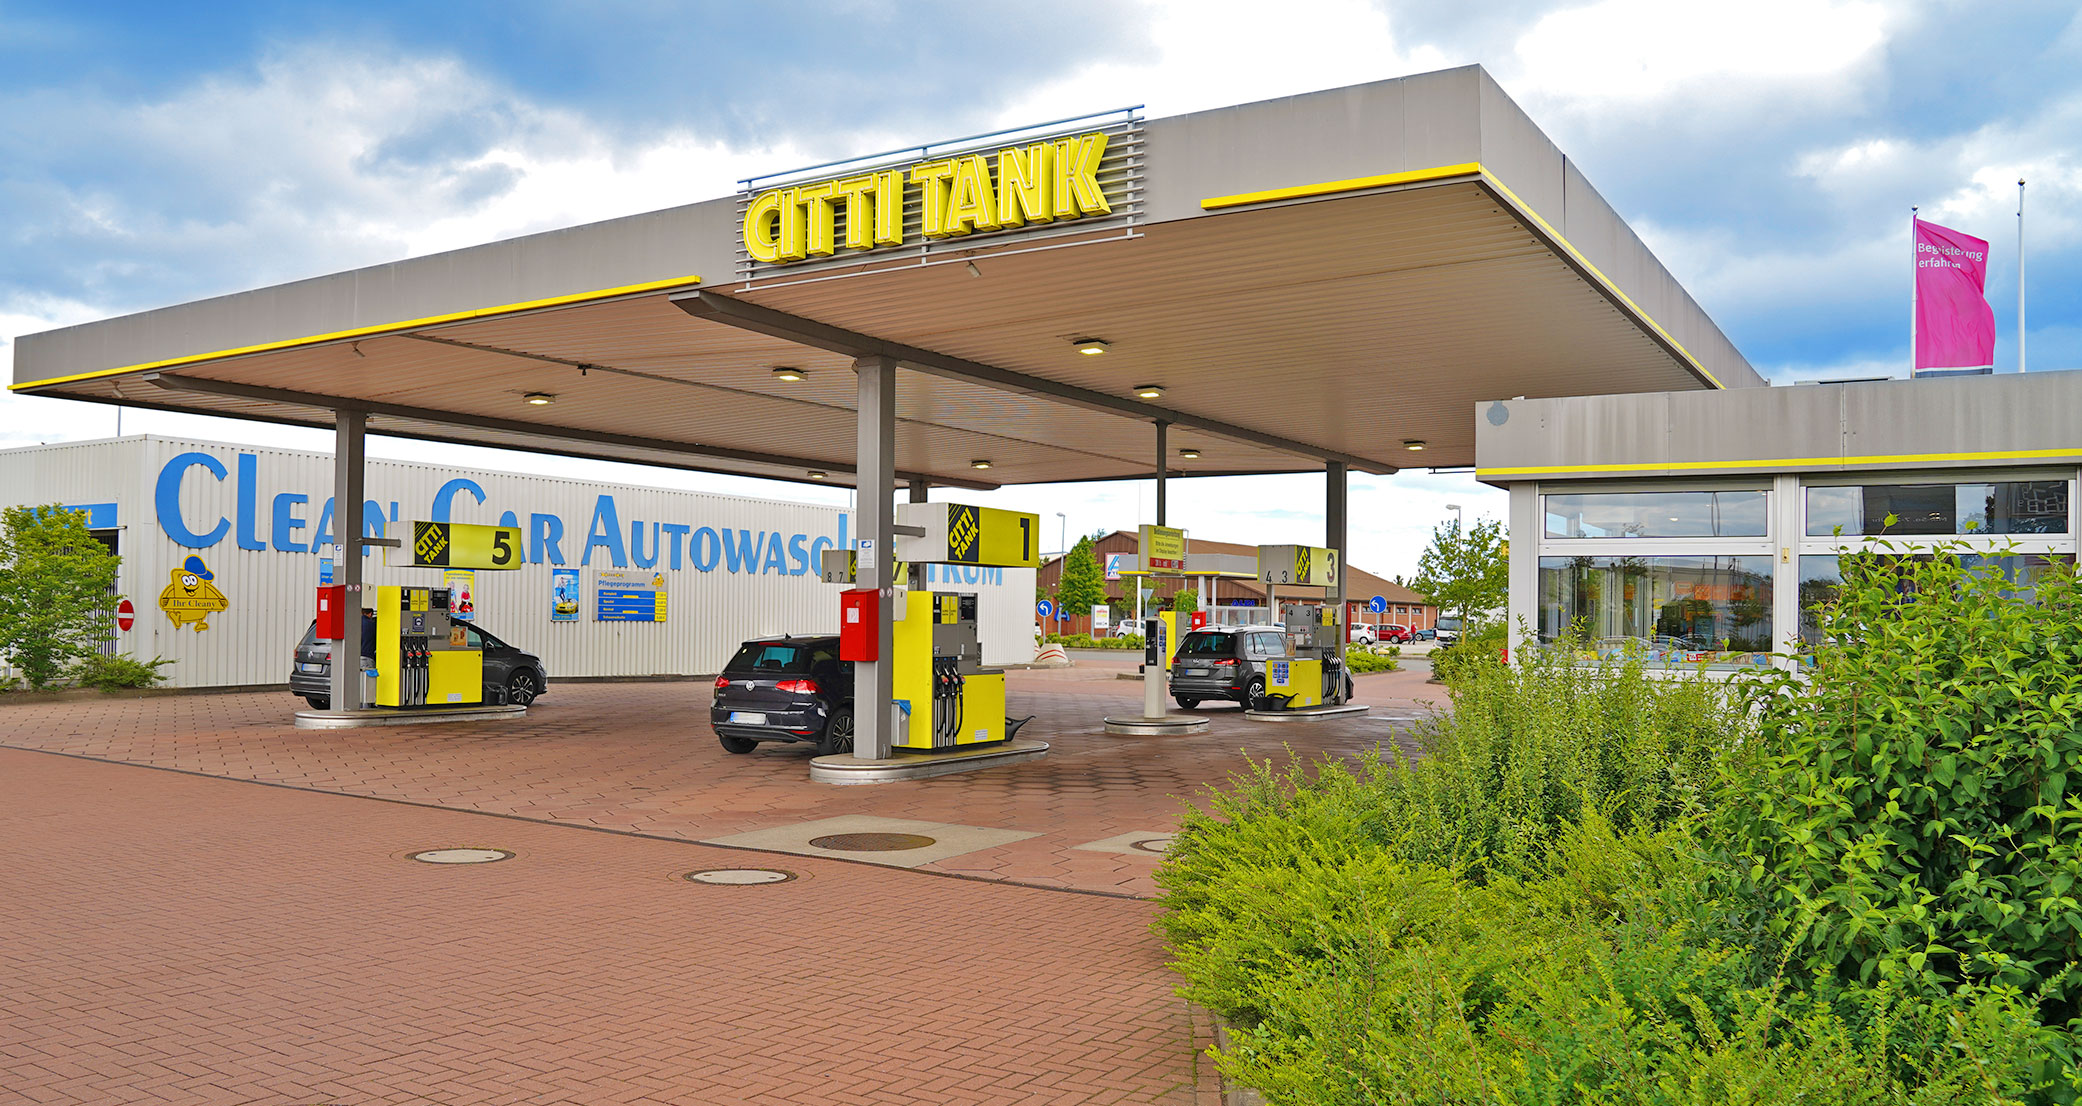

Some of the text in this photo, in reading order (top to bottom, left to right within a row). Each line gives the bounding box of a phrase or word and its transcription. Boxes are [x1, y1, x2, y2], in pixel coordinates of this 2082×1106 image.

[743, 131, 1112, 264] CITTI TANK
[415, 523, 443, 556] CITTI
[948, 507, 974, 549] CITTI
[954, 522, 979, 561] TANK
[1019, 517, 1030, 562] 1
[424, 536, 449, 565] TANK
[491, 530, 512, 566] 5
[827, 571, 844, 582] 8 7
[1265, 570, 1288, 583] 4 3
[1327, 552, 1336, 584] 3
[598, 579, 646, 588] Pflegeprogramm
[173, 599, 216, 609] Ihr Cleany
[445, 613, 450, 621] 5
[1288, 609, 1311, 617] 4 3
